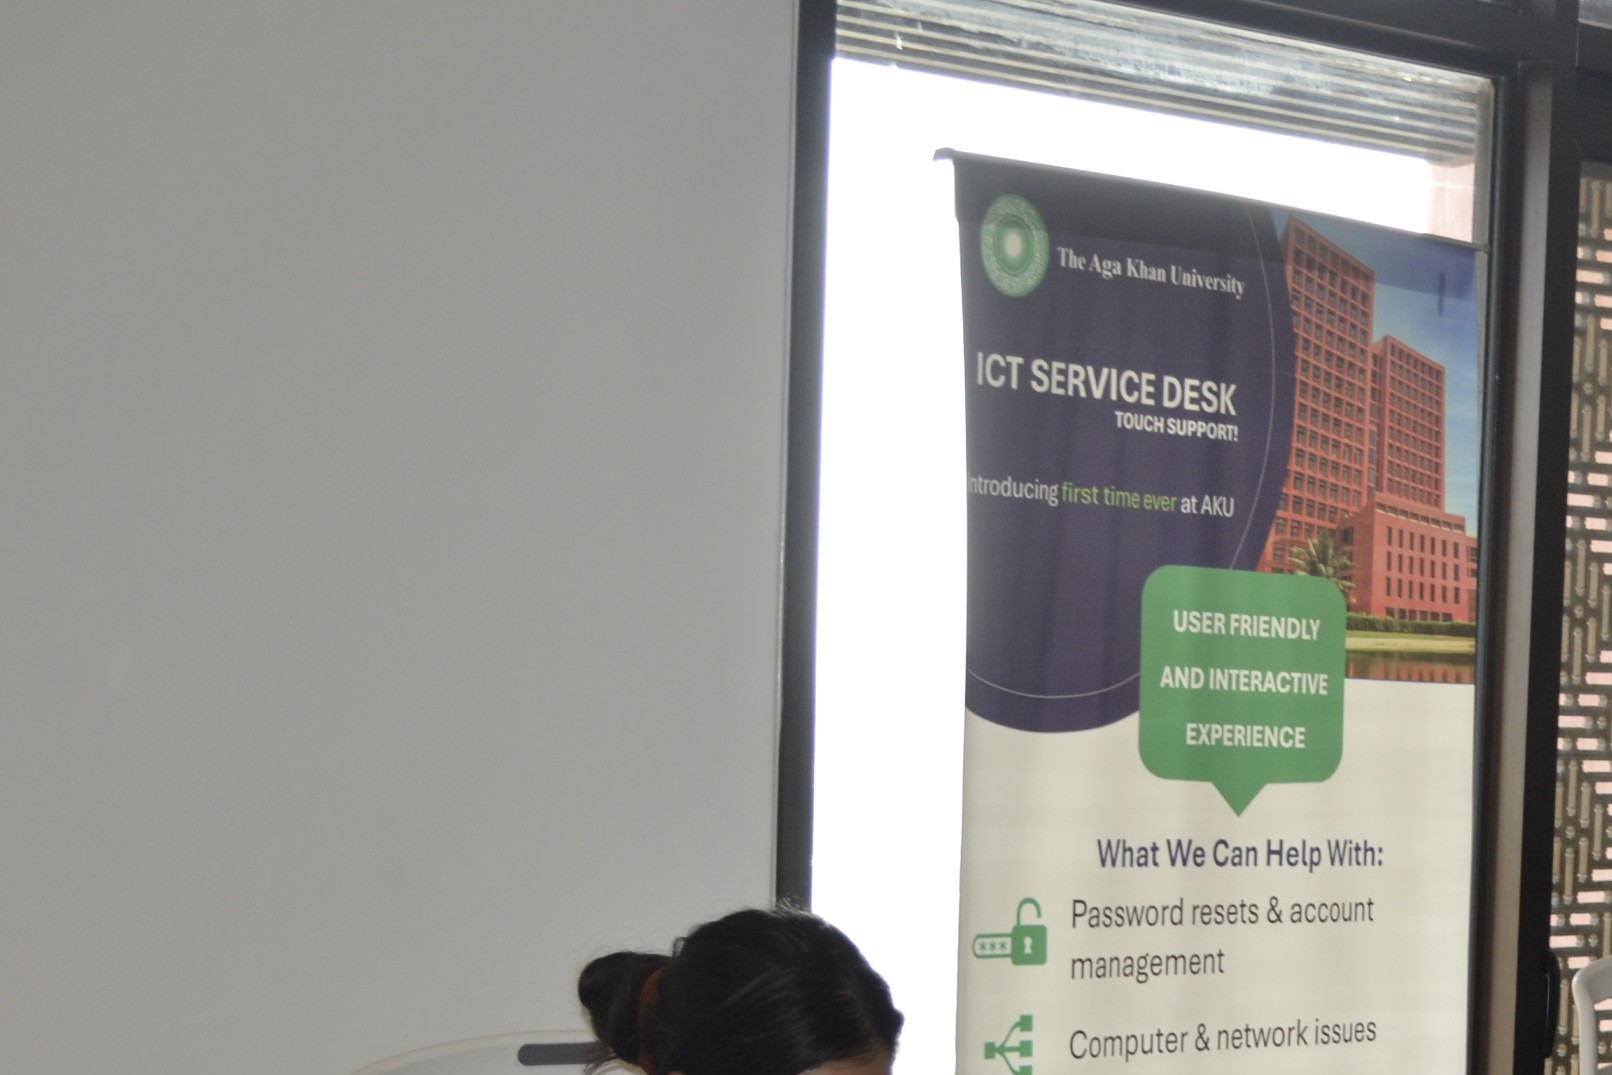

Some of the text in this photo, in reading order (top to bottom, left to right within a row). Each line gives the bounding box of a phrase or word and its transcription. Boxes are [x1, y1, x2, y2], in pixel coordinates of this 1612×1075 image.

[1057, 246, 1245, 299] The Aga Khan University
[977, 351, 1237, 416] ICT SERVICE DESK
[1115, 410, 1239, 442] TOUCH SUPPORT!
[1061, 481, 1099, 505] first
[1103, 486, 1140, 508] time
[1143, 491, 1178, 512] ever
[1180, 495, 1197, 514] at
[1200, 495, 1235, 518] AKU
[1174, 609, 1321, 641] USER FRIENDLY
[1160, 666, 1328, 695] AND INTERACTIVE
[1186, 722, 1305, 748] EXPERIENCE
[1097, 839, 1384, 873] What We Can Help With:
[1072, 897, 1374, 928] Password resets & account
[1071, 949, 1225, 984] management
[1069, 1018, 1377, 1062] Computer & network issues
